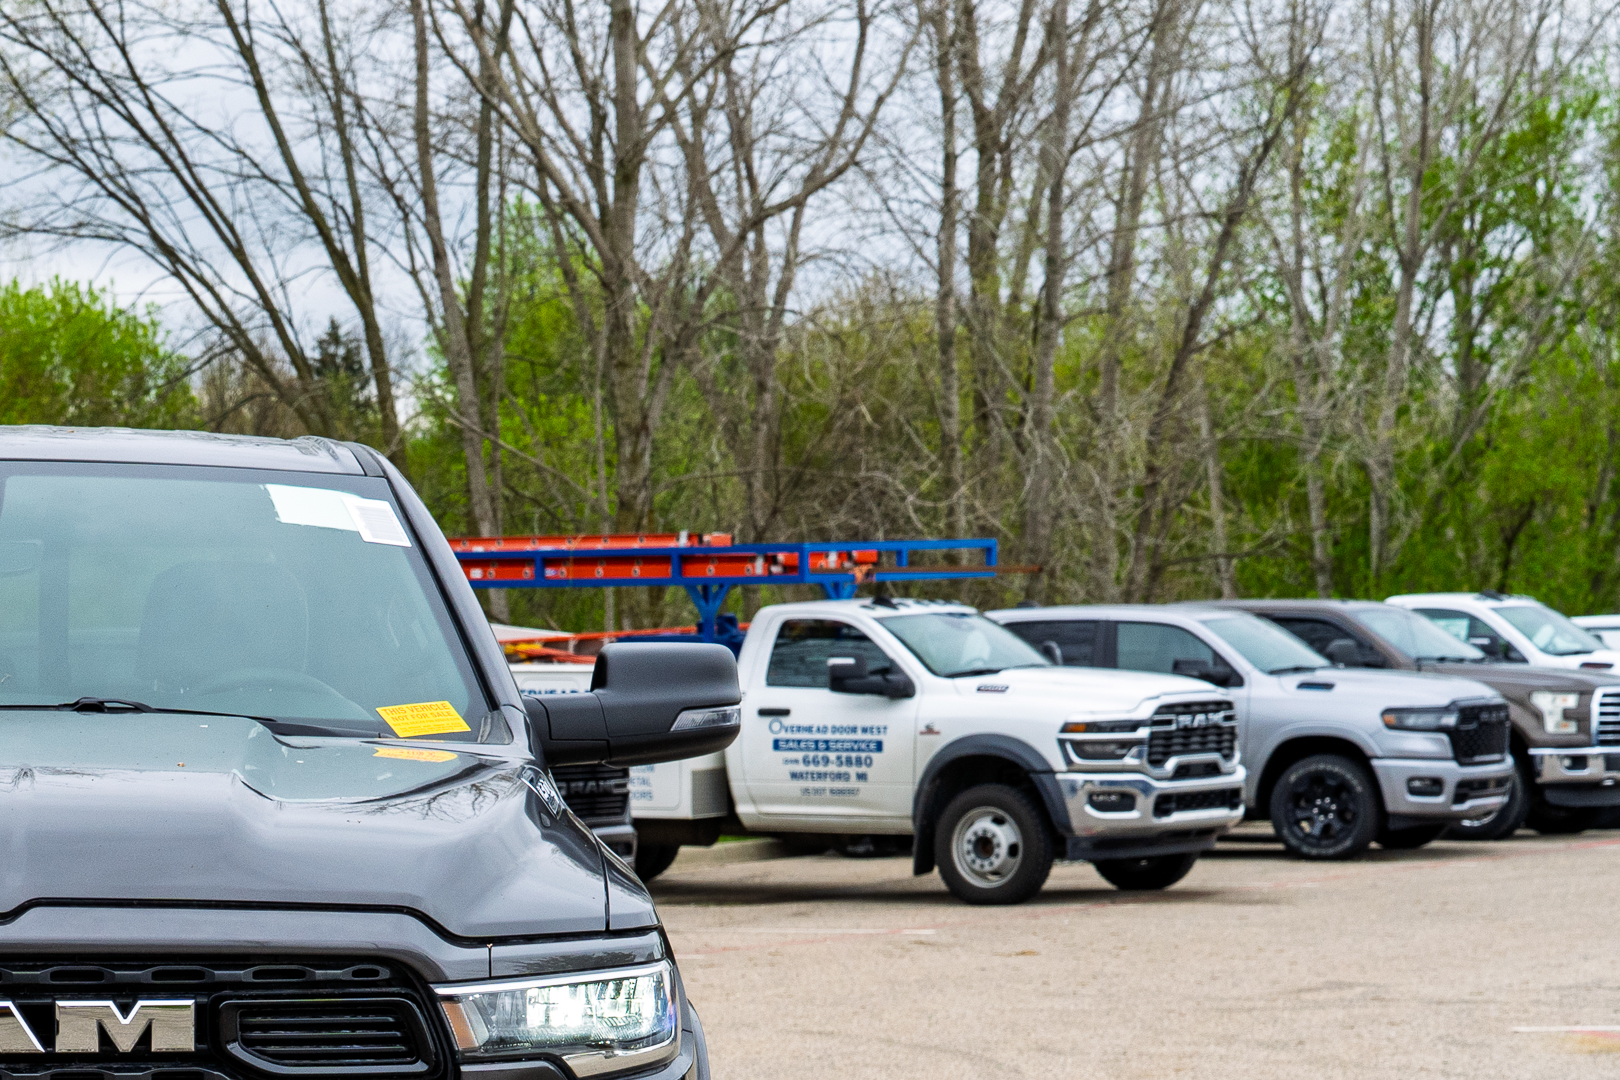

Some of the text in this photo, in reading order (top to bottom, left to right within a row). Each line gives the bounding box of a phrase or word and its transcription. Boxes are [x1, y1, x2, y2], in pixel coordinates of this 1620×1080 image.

[382, 703, 450, 716] THIS VEHICLE
[391, 711, 453, 722] NOT FOR SALE
[768, 718, 888, 735] OVERHEAD DOOR WEST
[778, 740, 815, 750] SALES
[829, 740, 878, 751] SERVICE
[802, 754, 874, 768] 669-5880
[789, 771, 851, 782] WATERFORD
